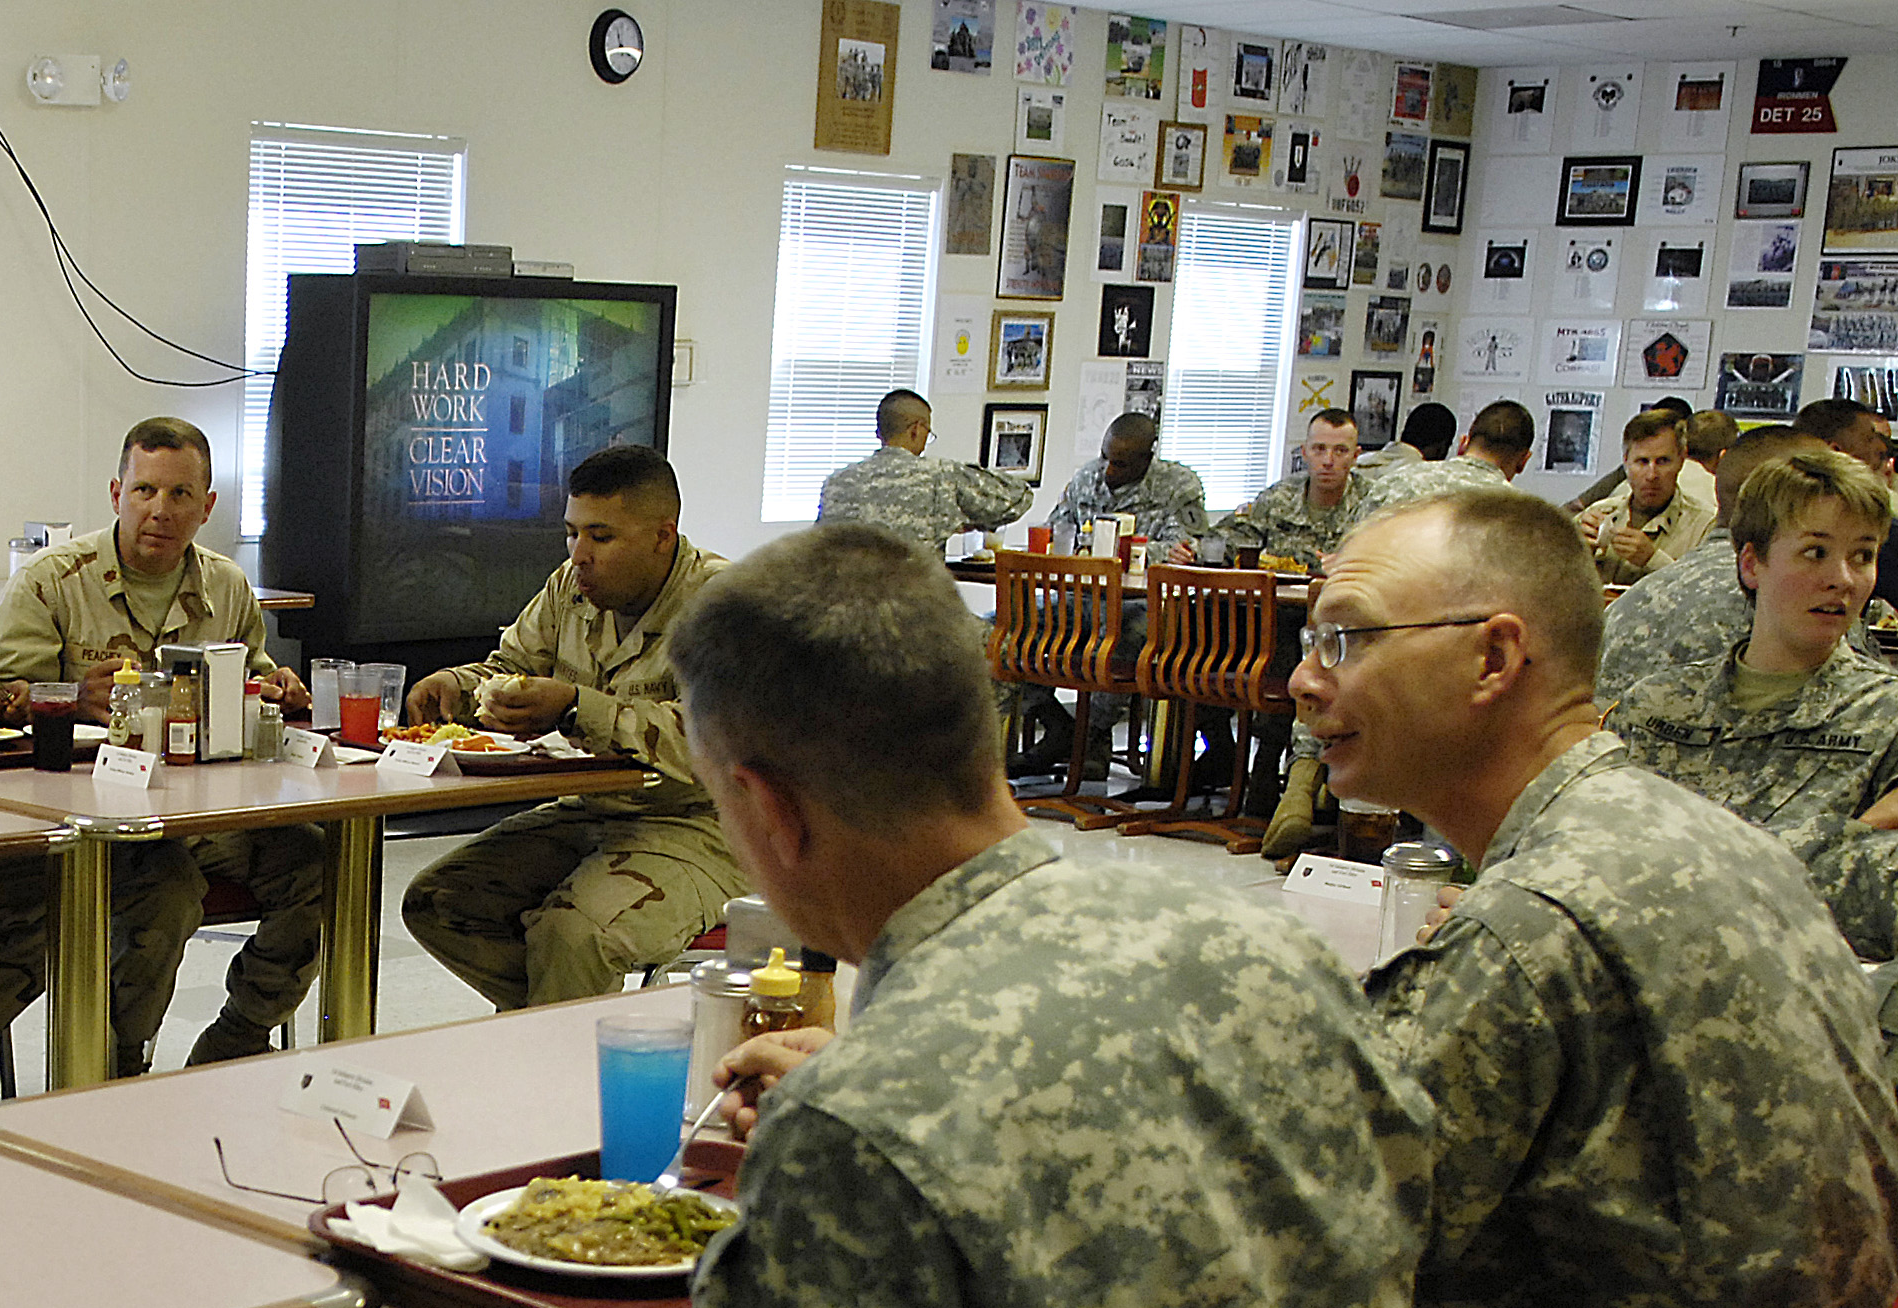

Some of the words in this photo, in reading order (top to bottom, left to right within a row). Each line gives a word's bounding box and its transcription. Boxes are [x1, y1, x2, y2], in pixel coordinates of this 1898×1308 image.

[1760, 107, 1795, 123] DET
[1802, 107, 1822, 122] 25
[410, 361, 492, 391] HARD
[411, 394, 485, 422] WORK
[409, 437, 487, 465] CLEAR
[409, 468, 485, 496] VISION
[643, 681, 668, 695] NAVY
[1817, 733, 1863, 748] ARMY
